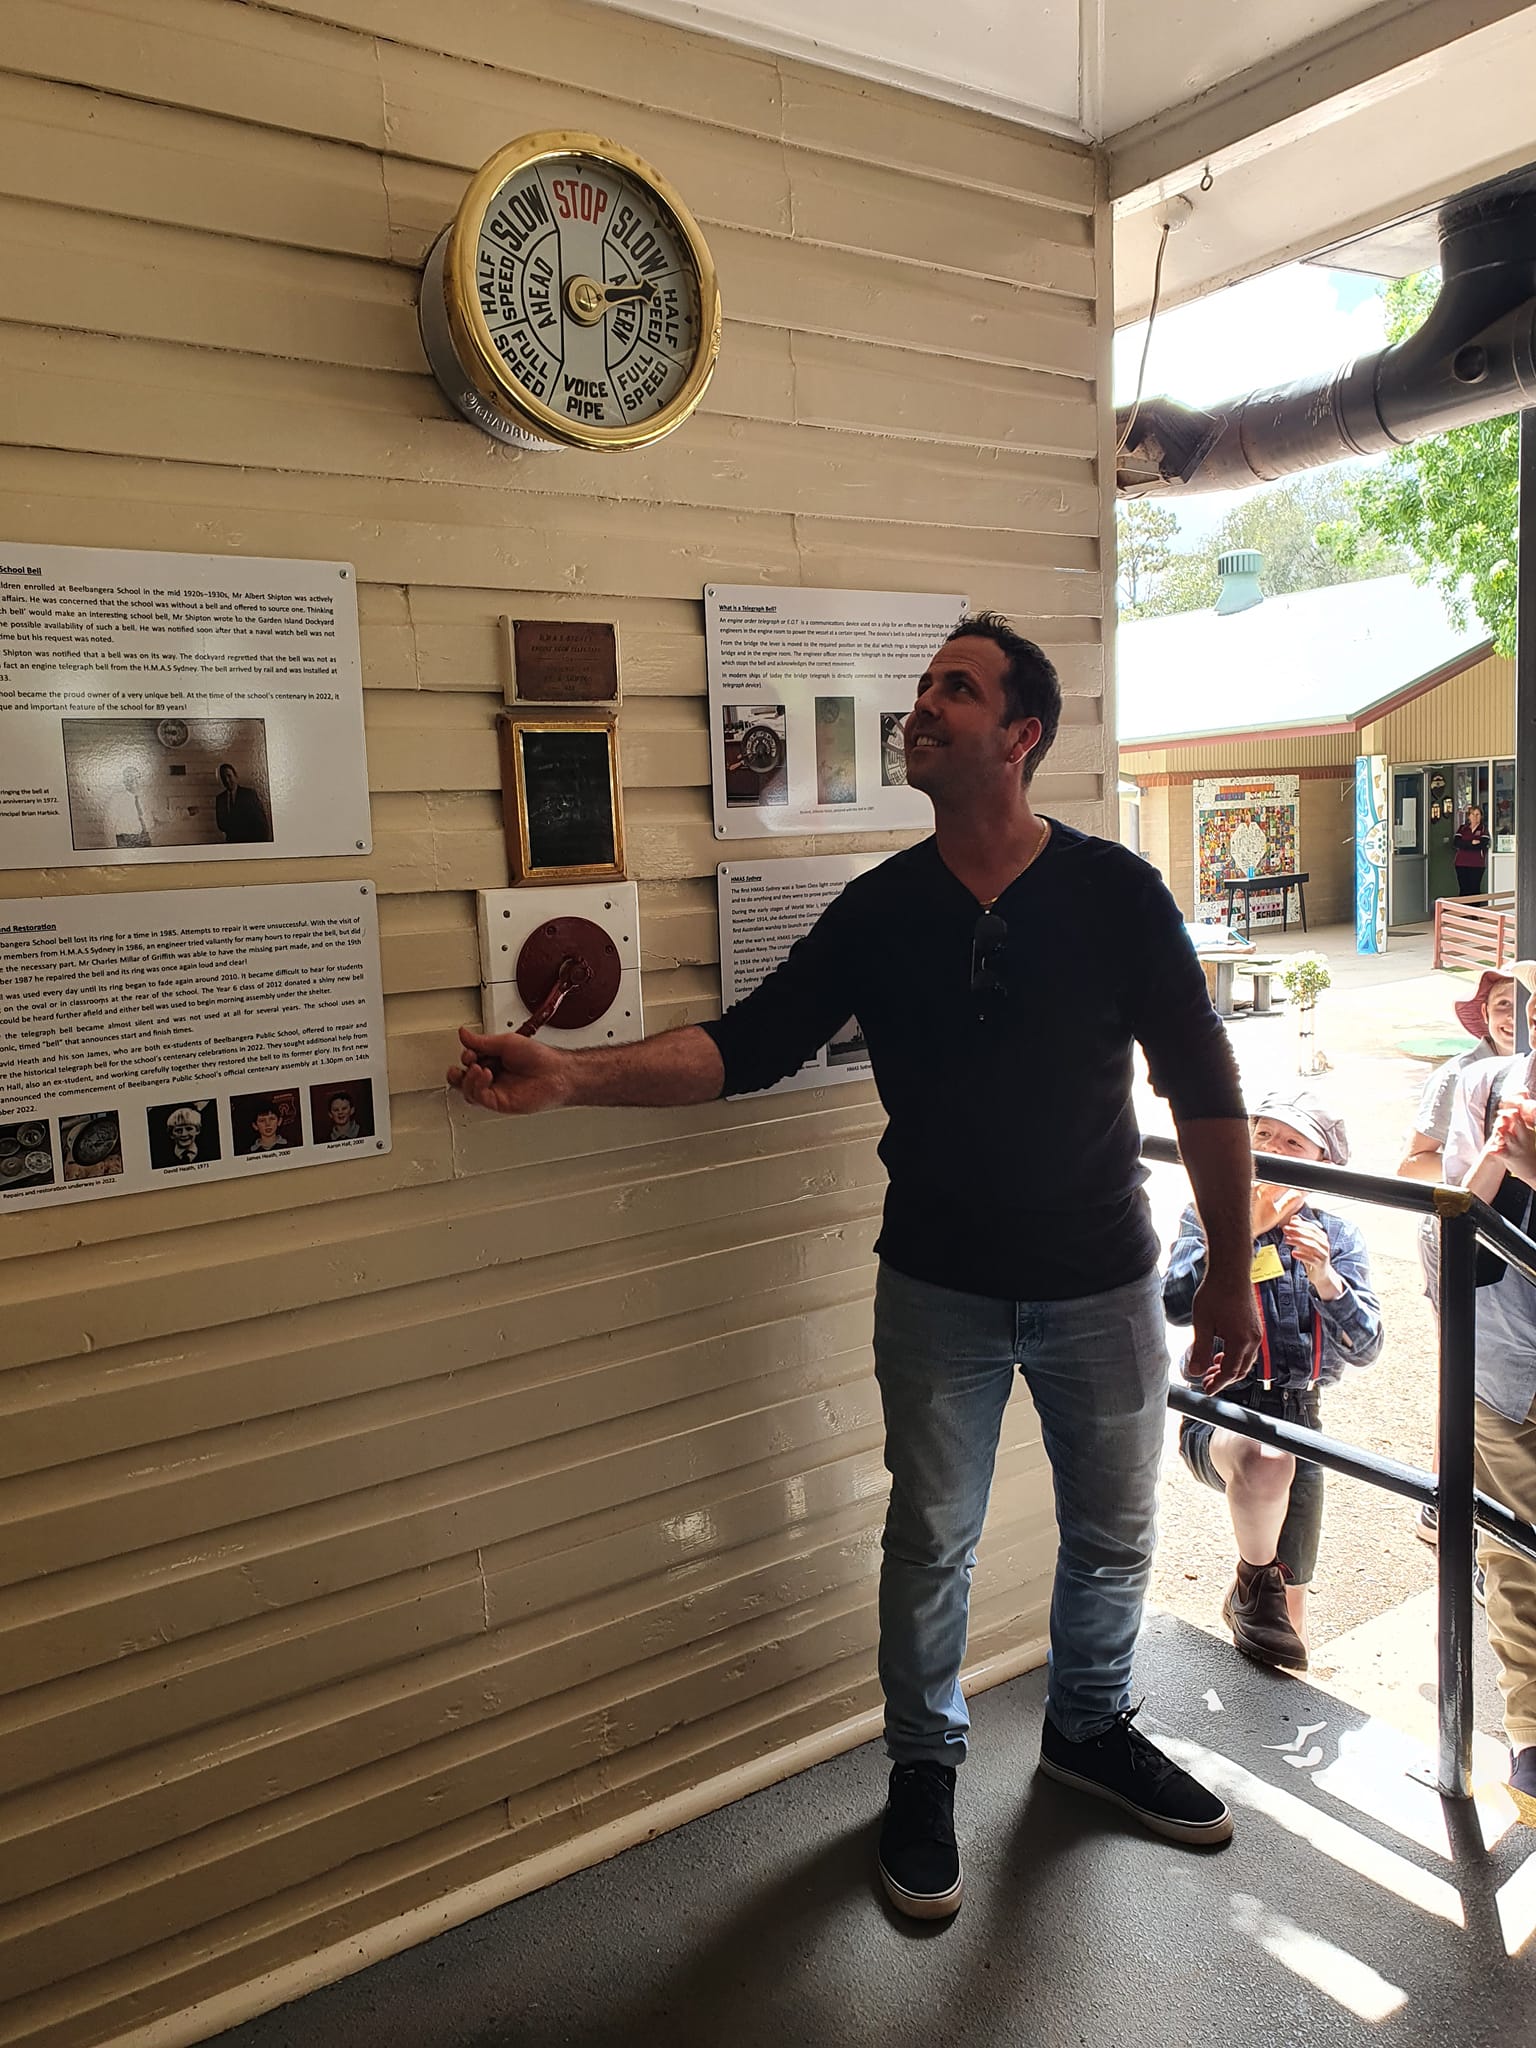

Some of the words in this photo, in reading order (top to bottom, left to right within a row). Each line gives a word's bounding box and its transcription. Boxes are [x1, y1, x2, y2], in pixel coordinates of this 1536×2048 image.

[490, 183, 550, 252] SLOW
[552, 179, 609, 225] STOP
[611, 206, 669, 281] SLOW
[479, 250, 498, 315] HALF
[499, 255, 518, 321] SPEED
[528, 256, 558, 329] AHEAD
[609, 273, 637, 346] ATERN
[647, 283, 663, 345] PEED
[663, 288, 680, 349] HALF
[493, 333, 546, 398] SPEED
[511, 329, 550, 380] FULL
[616, 354, 654, 391] FULL
[564, 374, 609, 398] VOICE
[566, 396, 605, 420] PIPE
[623, 360, 669, 411] SPEED
[12, 922, 56, 932] Restoration
[31, 937, 56, 946] School
[58, 936, 72, 944] bell
[73, 935, 88, 944] lost
[88, 934, 98, 942] its
[99, 933, 114, 943] ring
[114, 932, 126, 941] for
[132, 931, 149, 939] time
[150, 930, 158, 938] in
[180, 926, 211, 936] Attempts
[212, 926, 220, 934] to
[221, 924, 241, 934] repair
[242, 924, 248, 932] it
[310, 918, 326, 927] With
[326, 918, 338, 926] the
[338, 916, 352, 925] visit
[352, 916, 360, 924] of
[0, 1015, 20, 1025] could
[21, 1015, 31, 1023] be
[32, 1012, 54, 1022] heard
[55, 1010, 81, 1020] further
[82, 1007, 102, 1017] afield
[104, 1006, 118, 1015] and
[118, 1004, 140, 1013] either
[140, 1002, 154, 1011] bell
[154, 1002, 169, 1010] was
[170, 999, 187, 1008] used
[187, 999, 196, 1007] to
[196, 997, 215, 1007] begin
[216, 994, 244, 1004] morning
[245, 991, 275, 1002] assembly
[276, 990, 296, 999] under
[296, 988, 307, 997] the
[0, 1092, 41, 1104] announced
[43, 1090, 56, 1099] the
[58, 1082, 116, 1097] commencement
[117, 1081, 125, 1090] of
[126, 1077, 170, 1089] Beelbangera
[171, 1073, 192, 1083] Public
[223, 1066, 245, 1077] official
[246, 1064, 279, 1074] centenary
[280, 1059, 310, 1070] assembly
[311, 1058, 318, 1066] at
[320, 1056, 343, 1065] 1.30pm
[354, 1052, 369, 1061] 14th
